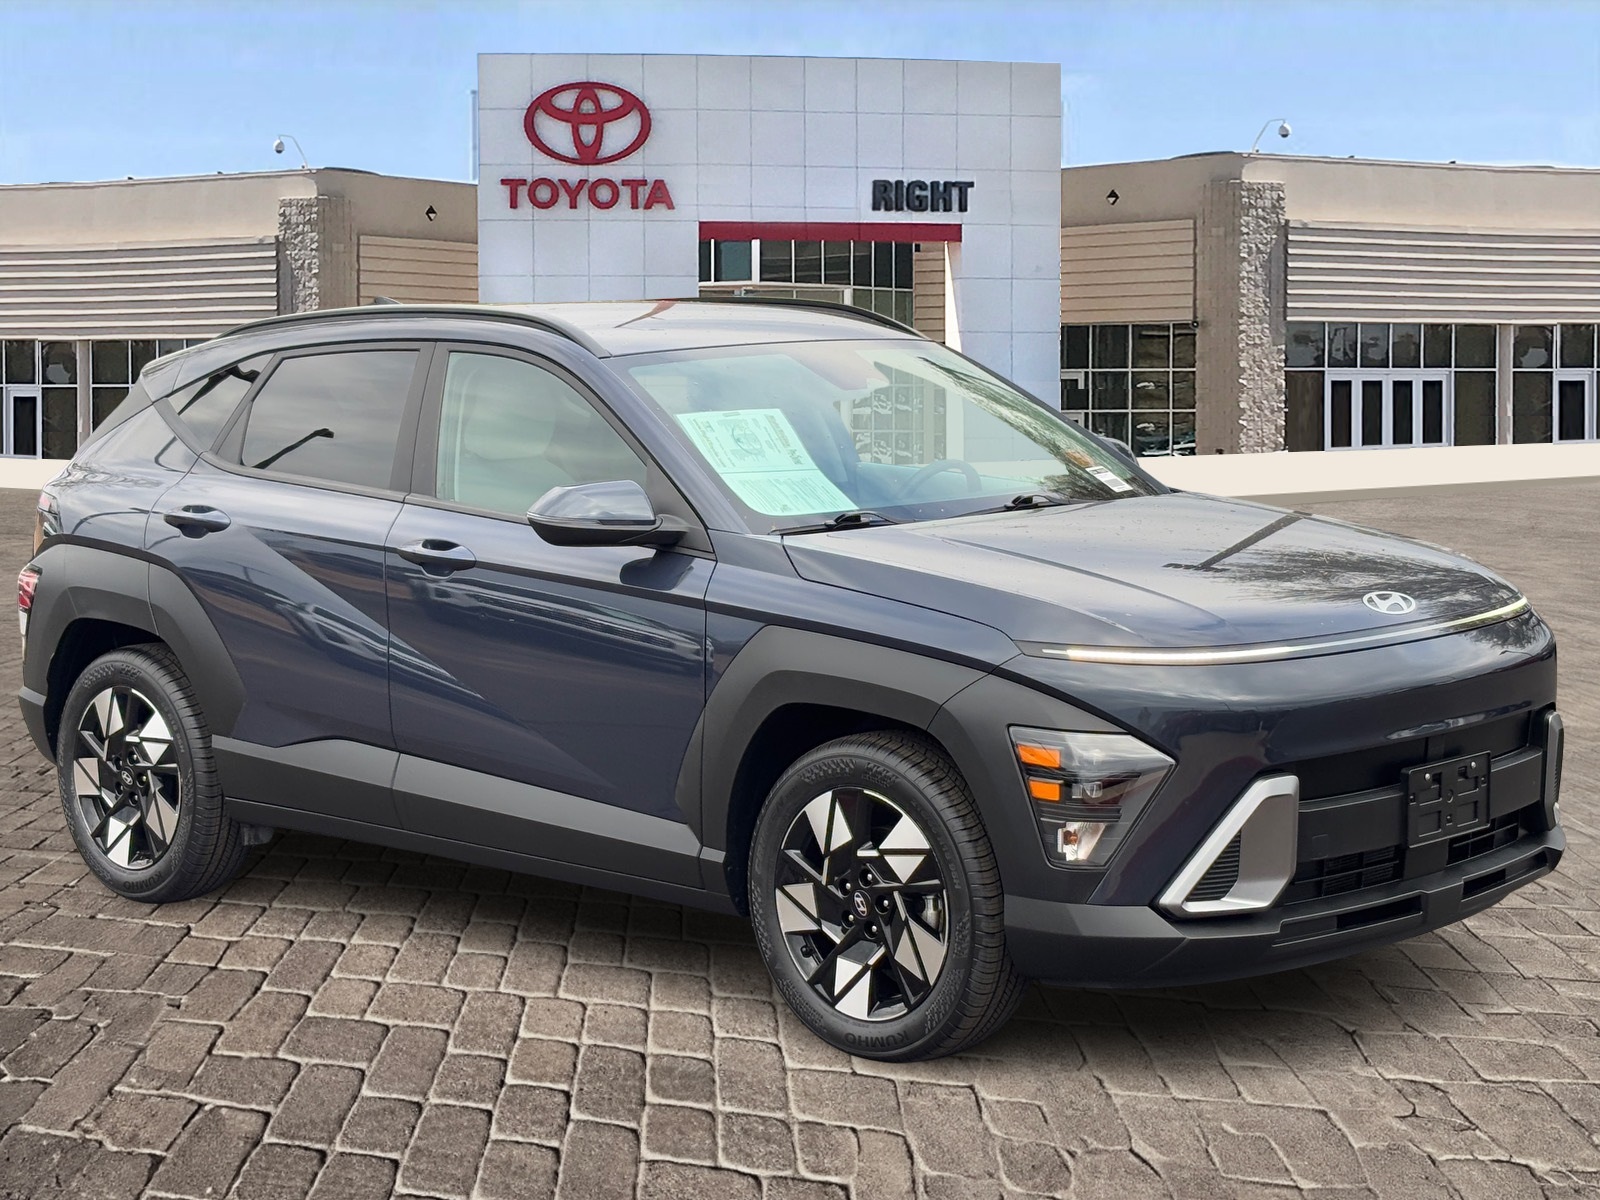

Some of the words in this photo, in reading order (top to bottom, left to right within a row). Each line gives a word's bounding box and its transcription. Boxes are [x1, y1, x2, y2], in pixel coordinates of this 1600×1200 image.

[500, 178, 675, 210] TOYOTA
[871, 179, 975, 213] RIGHT
[844, 1030, 910, 1048] KUMHO
